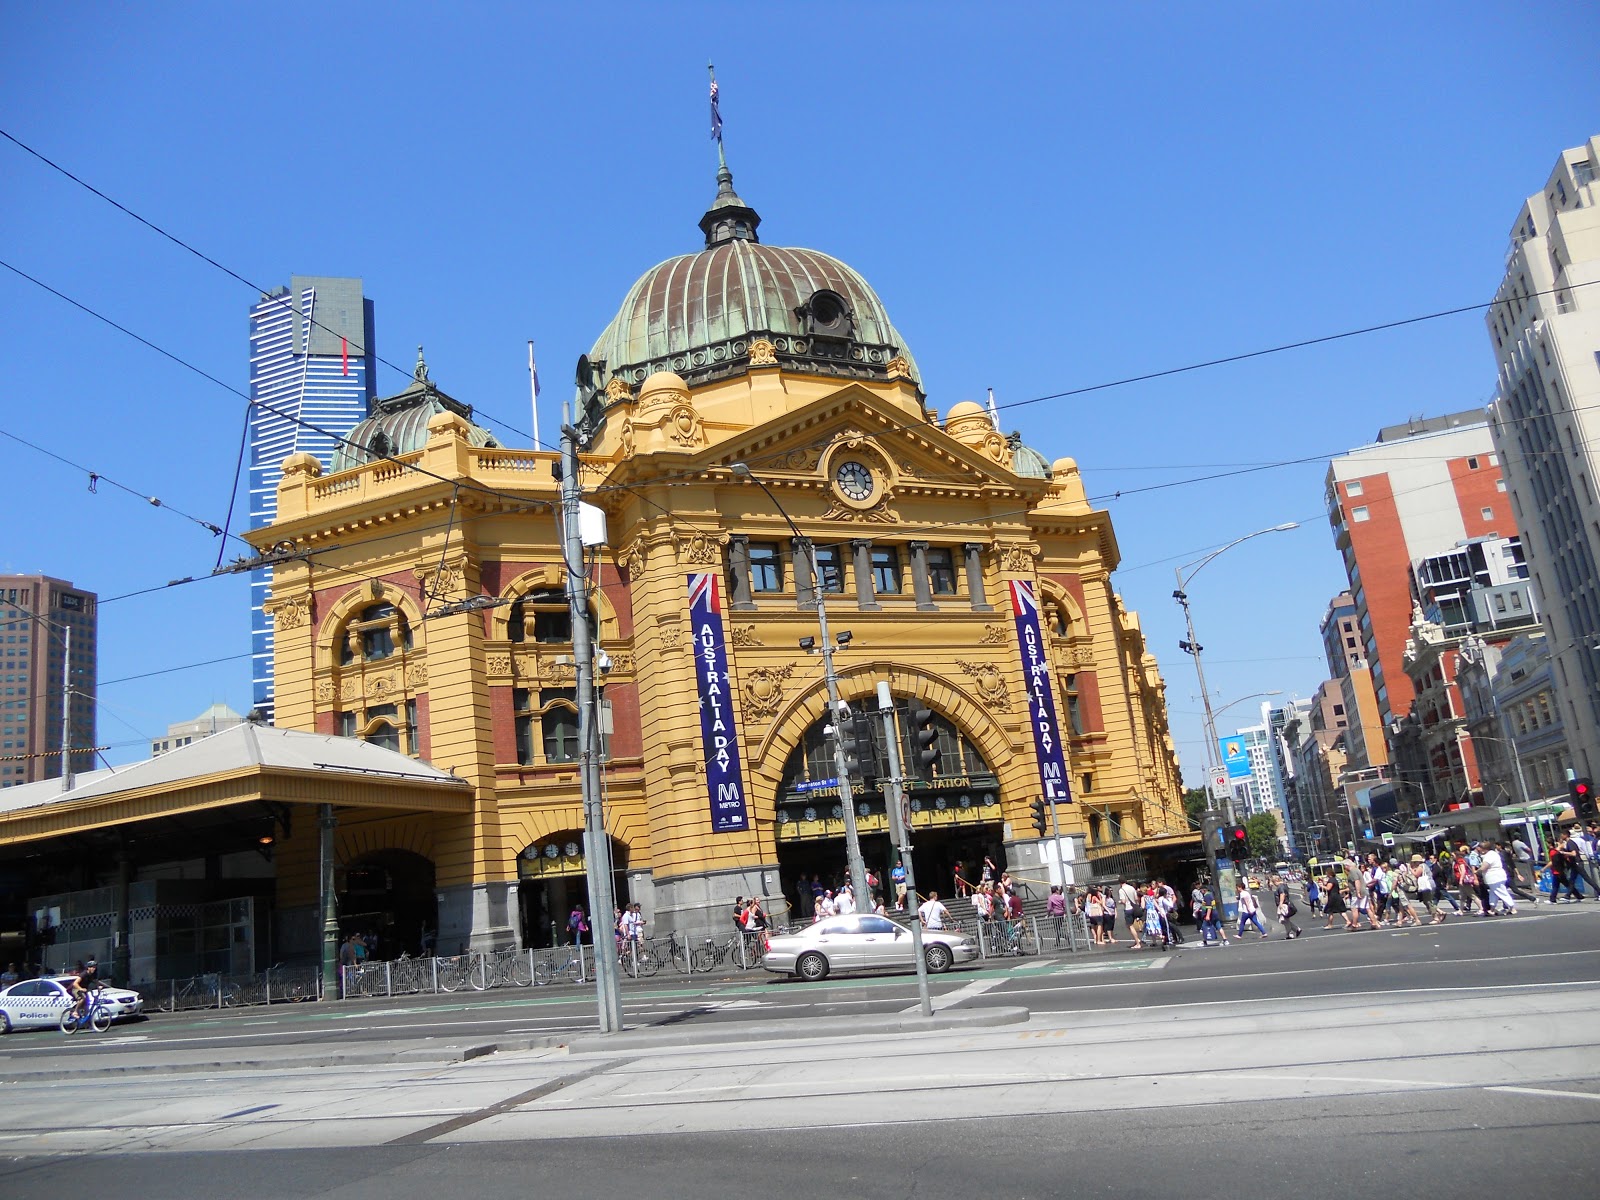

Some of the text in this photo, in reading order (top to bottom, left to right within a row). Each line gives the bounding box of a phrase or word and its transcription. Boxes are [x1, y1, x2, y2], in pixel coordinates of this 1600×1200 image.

[701, 624, 730, 773] AUSTRALIA DAY
[1024, 624, 1053, 754] AUSTRALIA DAY
[719, 801, 740, 809] METRO
[925, 777, 971, 790] STATION
